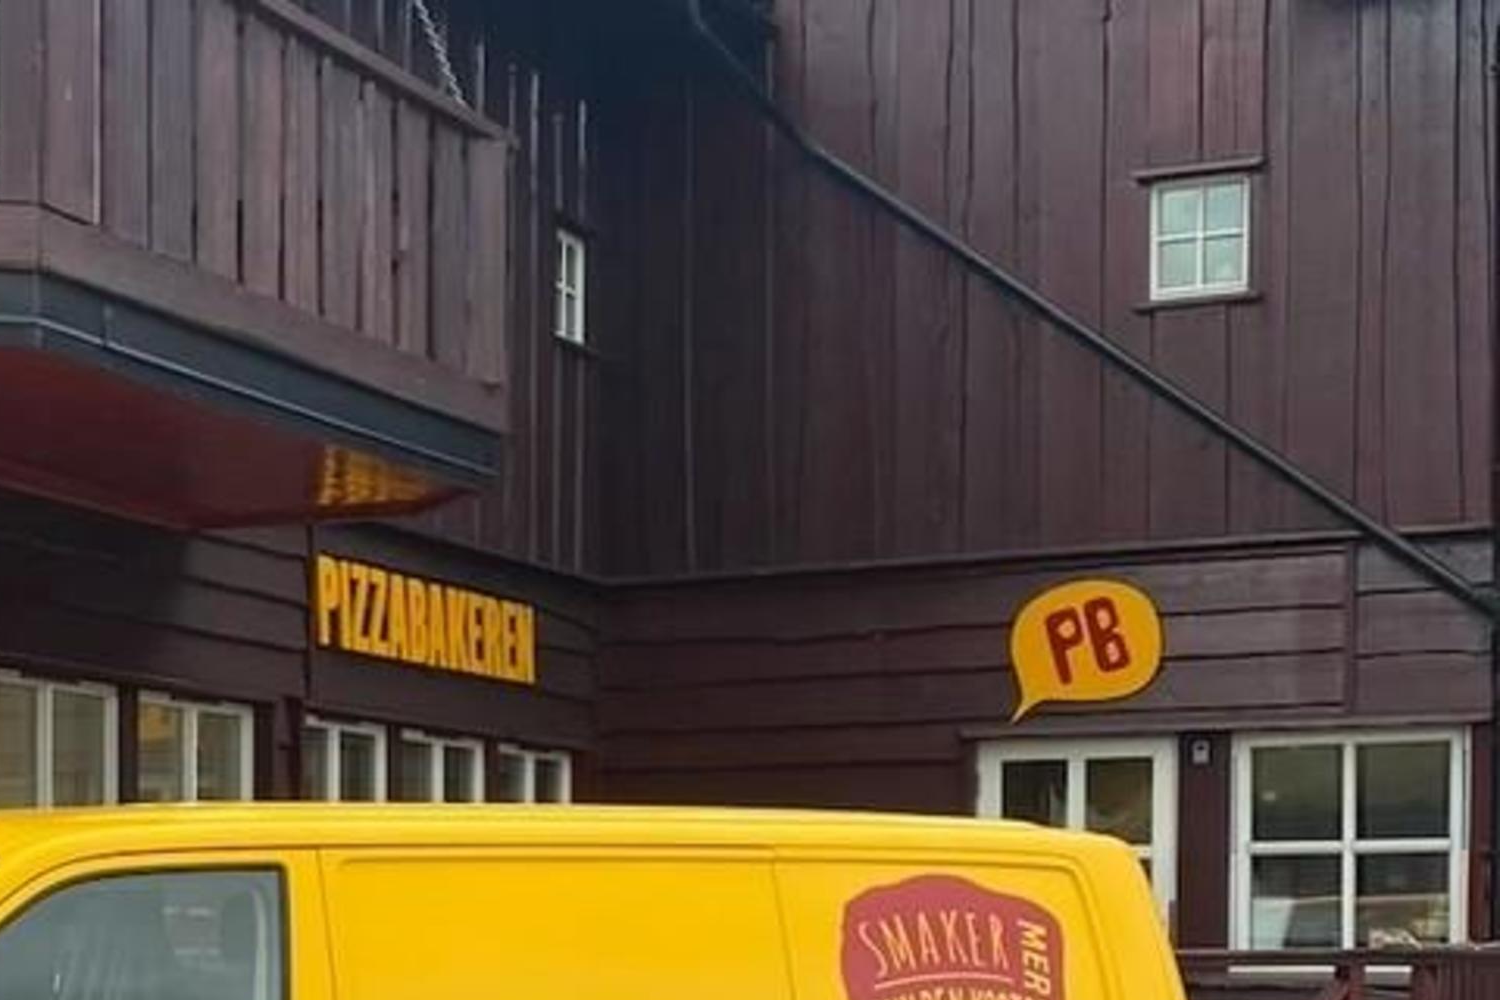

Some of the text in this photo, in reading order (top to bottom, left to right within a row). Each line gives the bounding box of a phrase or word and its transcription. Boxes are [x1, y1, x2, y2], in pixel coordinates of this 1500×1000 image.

[316, 554, 536, 685] PIZZABAKEREN
[1044, 596, 1131, 685] PB
[858, 910, 1008, 978] SMAKER
[1016, 918, 1051, 996] MER
